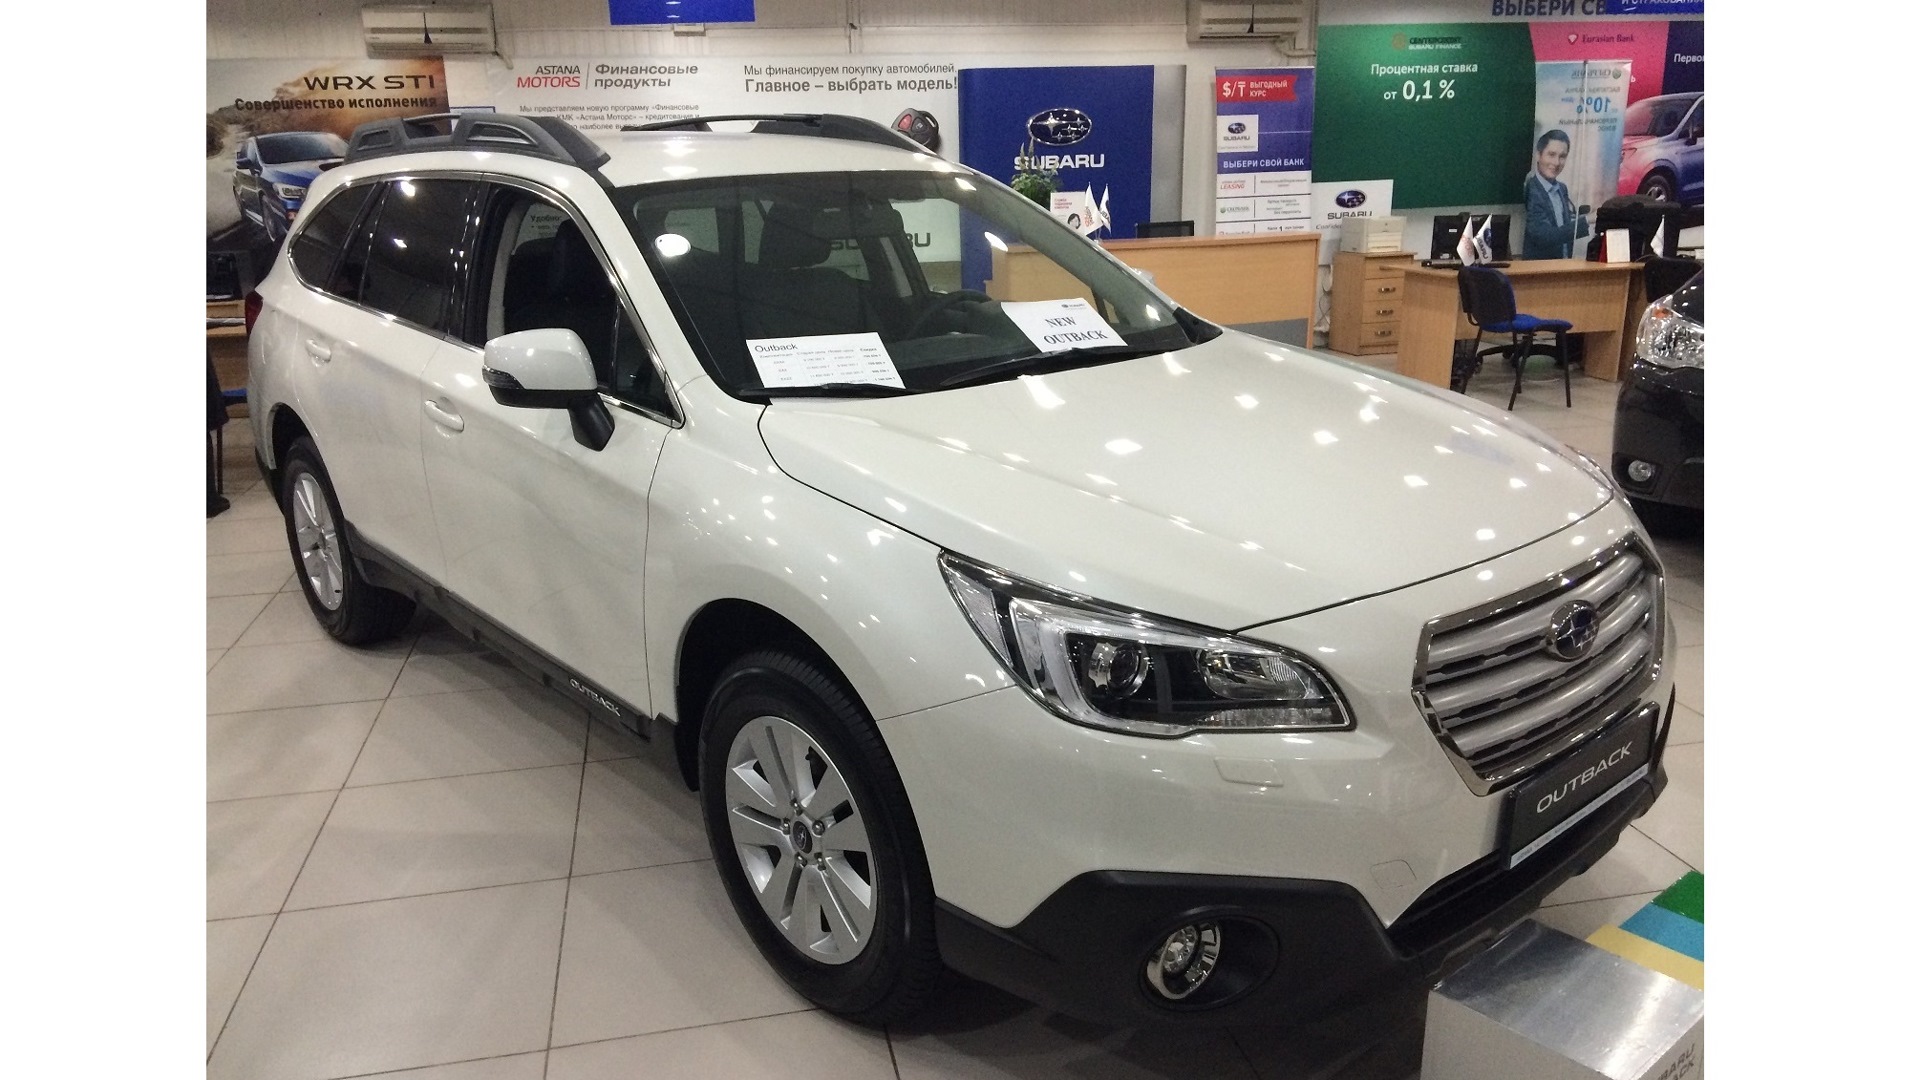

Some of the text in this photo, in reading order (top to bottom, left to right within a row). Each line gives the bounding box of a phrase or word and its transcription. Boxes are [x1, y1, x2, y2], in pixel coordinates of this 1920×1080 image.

[1492, 0, 1605, 16] ВЫБЕРИ СВ
[1582, 34, 1634, 43] Eurasian Bank
[1673, 53, 1704, 64] Перво
[536, 65, 581, 75] ASTANA
[595, 64, 699, 75] Финансовые
[744, 64, 957, 77] Мы финансируем покупку автомобилей.
[1371, 63, 1478, 76] Процентная ставка
[304, 75, 435, 90] WRX STI
[517, 76, 581, 88] MOTORS
[594, 78, 671, 88] продукты
[745, 79, 810, 93] Главное
[828, 78, 892, 94] выбрать
[897, 77, 957, 92] модель!
[1249, 80, 1288, 89] ВЫГОДНЫЙ
[1383, 79, 1455, 101] от 0,1 %
[235, 97, 437, 112] Совершенство исполнения
[534, 106, 585, 114] представляем
[1014, 154, 1105, 171] SUBARU
[1223, 158, 1304, 169] ВЫБЕРИ СВОЙ БАНК
[1327, 211, 1373, 220] SUBARU
[1045, 317, 1077, 329] NEW
[1043, 330, 1108, 345] OUTBACK
[754, 343, 798, 353] Outback
[569, 678, 620, 717] OUTBACK
[1536, 741, 1632, 813] OUTBACK
